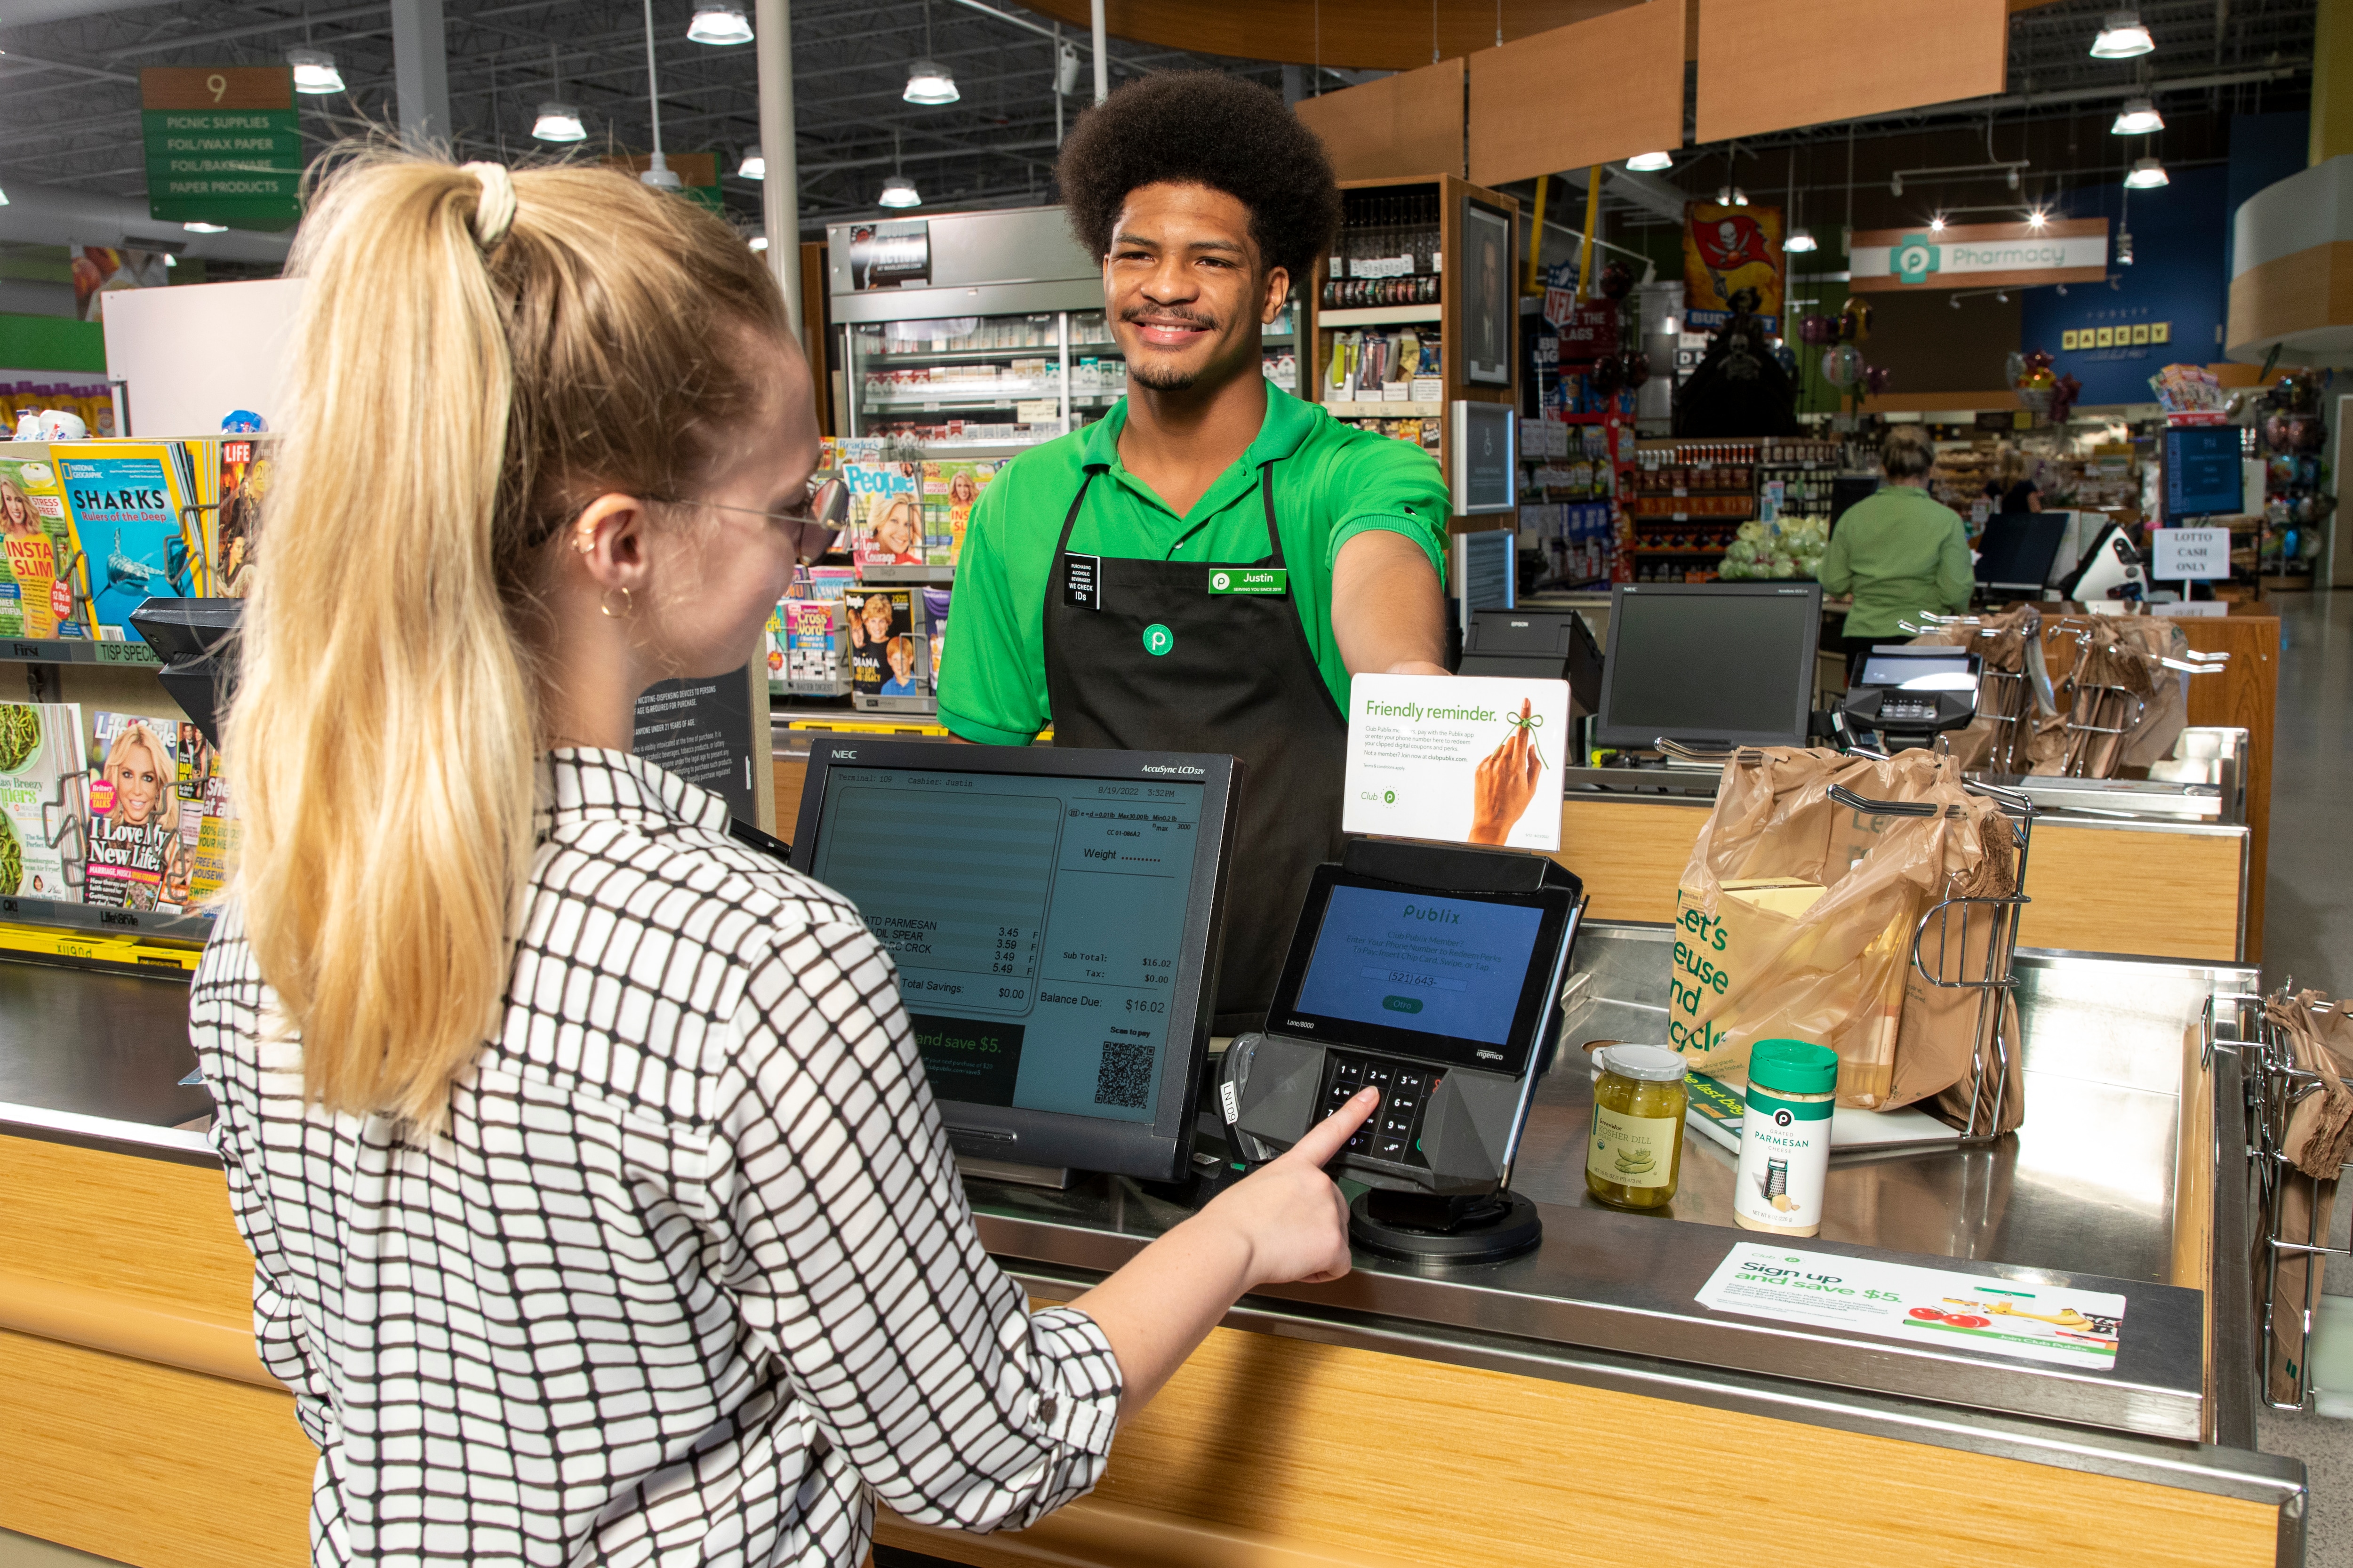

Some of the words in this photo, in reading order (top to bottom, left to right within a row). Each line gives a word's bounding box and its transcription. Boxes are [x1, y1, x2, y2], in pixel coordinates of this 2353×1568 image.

[207, 74, 227, 103] 9
[167, 117, 209, 128] PICNIC
[213, 117, 269, 129] SUPPLIES
[168, 139, 232, 150] FOIL/WAX
[235, 139, 273, 150] PAPER
[170, 182, 209, 193] PAPER
[211, 181, 278, 192] PRODUCTS
[1953, 245, 2065, 266] Pharmacy
[1546, 289, 1574, 325] NFL
[2064, 325, 2166, 347] BAKERY
[839, 440, 879, 448] Reader's
[226, 445, 250, 462] LIFE
[846, 466, 914, 499] People
[32, 498, 58, 506] STRESS
[74, 489, 165, 509] SHARKS
[39, 506, 58, 515] FREE!
[81, 512, 108, 521] Rulers
[110, 512, 120, 521] of
[122, 512, 139, 521] the
[141, 512, 167, 523] Deep
[2174, 532, 2213, 543] LOTTO
[6, 541, 54, 560] INSTA
[2177, 548, 2208, 557] CASH
[14, 560, 53, 578] SLIM
[2176, 562, 2208, 573] ONLY
[1243, 573, 1273, 582] Justin
[56, 581, 67, 591] Drop
[1077, 584, 1093, 592] CHECK
[1075, 591, 1087, 601] IDs
[797, 611, 827, 624] Cross
[14, 643, 39, 657] First
[101, 645, 121, 660] TISP
[123, 646, 163, 662] SPECIA
[853, 657, 880, 668] DIANA
[638, 691, 679, 704] NICOTINE-DISPENSING
[679, 689, 695, 698] DEVICES
[700, 685, 716, 695] PERSONS
[650, 703, 669, 713] REQUIRED
[677, 698, 697, 709] PURCHASE.
[1367, 700, 1424, 722] Friendly
[1427, 704, 1497, 722] reminder.
[831, 750, 857, 759] NEC
[1428, 754, 1468, 762] clubpublix.com.
[1141, 764, 1177, 775] AccuSync
[14, 777, 43, 792] Breezy
[838, 774, 876, 783] Terminal:
[908, 777, 942, 786] Cashier:
[945, 779, 973, 787] Justin
[90, 792, 114, 800] FINALLY
[207, 777, 231, 800] She
[1098, 786, 1139, 796] 8/19/2022
[92, 800, 111, 808] TALKS
[1361, 792, 1378, 801] Club
[90, 816, 100, 839] I
[103, 817, 144, 844] Love
[144, 823, 171, 852] My
[88, 840, 131, 865] New
[1084, 848, 1117, 861] Weight
[194, 856, 211, 867] FREE
[3, 899, 18, 912] OK!
[1403, 904, 1461, 925] Publix
[1677, 889, 1729, 951] Let's
[885, 917, 937, 930] PARMESAN
[999, 927, 1018, 937] 3.45
[893, 930, 923, 941] SPEAR
[997, 939, 1017, 950] 3.59
[905, 943, 932, 954] CRCK
[995, 951, 1015, 961] 3.49
[1386, 941, 1409, 950] Phone
[1409, 944, 1439, 955] Number
[1480, 953, 1502, 963] Perks
[1064, 952, 1078, 960] Sub
[1080, 952, 1107, 962] Total:
[1143, 958, 1171, 968] $16.02
[1673, 940, 1729, 995] euse
[993, 963, 1013, 973] 5.49
[1086, 969, 1105, 978] Tax:
[1144, 974, 1169, 984] $0.00
[1389, 971, 1413, 984] (521)
[1414, 975, 1438, 986] 643-
[902, 978, 923, 989] Total
[926, 981, 964, 995] Savings:
[999, 988, 1024, 999] $0.00
[1040, 992, 1078, 1005] Balance
[1080, 995, 1103, 1007] Due:
[1125, 999, 1165, 1013] $16.02
[1393, 1000, 1412, 1010] Otro
[1287, 1019, 1315, 1029] Lane/8000
[1110, 1026, 1128, 1035] Scan
[1137, 1030, 1151, 1038] pay
[917, 1032, 943, 1047] and
[944, 1037, 976, 1050] save
[979, 1036, 1001, 1054] $5.
[1476, 1049, 1504, 1061] ingenico
[1693, 1084, 1726, 1099] last
[1224, 1085, 1236, 1121] LN109
[1600, 1117, 1623, 1131] GreenWise
[1598, 1125, 1629, 1142] KOSHER
[1631, 1135, 1651, 1145] DILL
[1755, 1131, 1809, 1148] PARMESAN
[1770, 1129, 1794, 1137] GRATED
[1768, 1145, 1792, 1154] CHEESE
[1740, 1262, 1800, 1276] Sign
[1806, 1273, 1842, 1284] up
[1735, 1272, 1789, 1285] and
[1791, 1280, 1856, 1296] save
[1863, 1289, 1903, 1303] $5.
[2022, 1338, 2051, 1347] Club
[2052, 1342, 2091, 1353] Publix.
